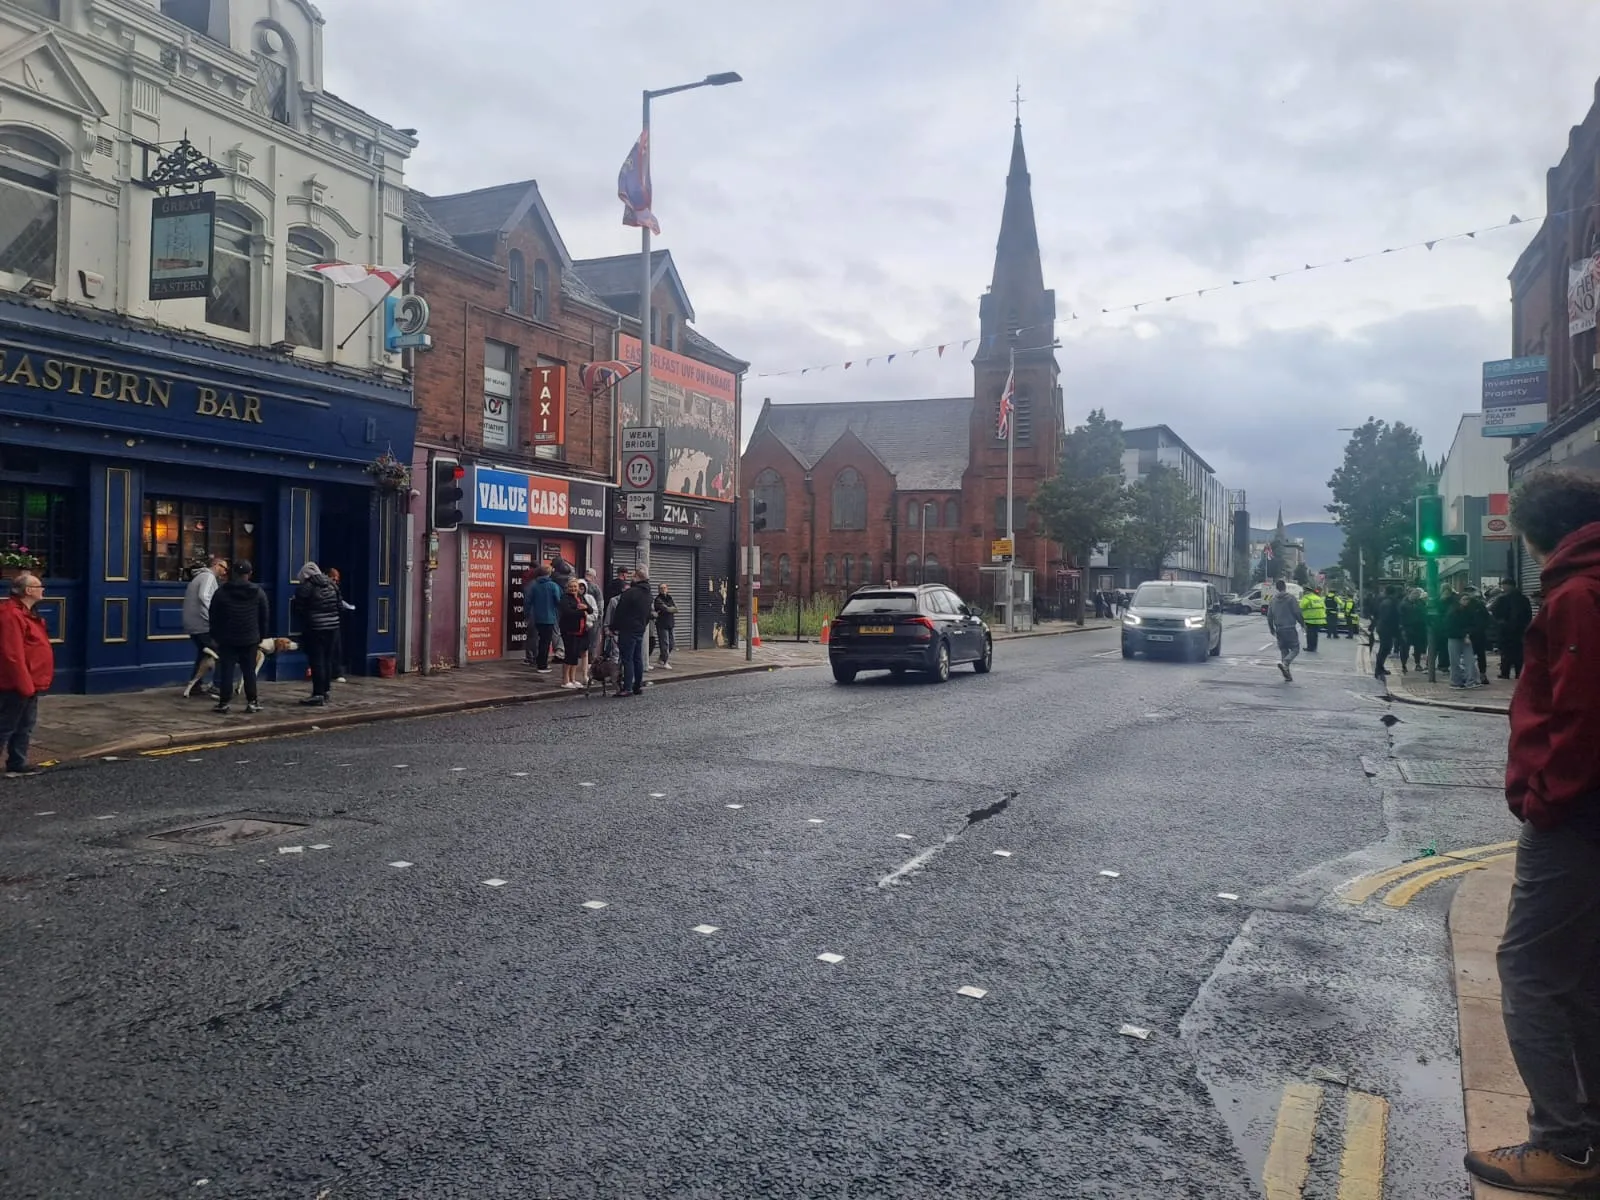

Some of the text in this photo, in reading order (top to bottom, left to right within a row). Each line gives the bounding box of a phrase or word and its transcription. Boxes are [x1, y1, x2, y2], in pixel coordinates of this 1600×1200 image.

[162, 199, 206, 213] GREAT
[154, 280, 205, 293] EASTERN
[1515, 359, 1547, 370] SALE
[682, 364, 695, 378] UVF
[1485, 376, 1539, 388] Investment
[1485, 388, 1528, 398] Property
[196, 386, 263, 423] BAR
[540, 370, 551, 432] TAXI
[629, 431, 653, 439] WEAK
[625, 441, 656, 449] BRIDGE
[631, 463, 643, 474] 17
[479, 483, 568, 517] VALUE CABS
[569, 506, 578, 515] 90
[586, 508, 595, 517] 90
[472, 539, 493, 549] PSV
[472, 550, 493, 560] TAXI
